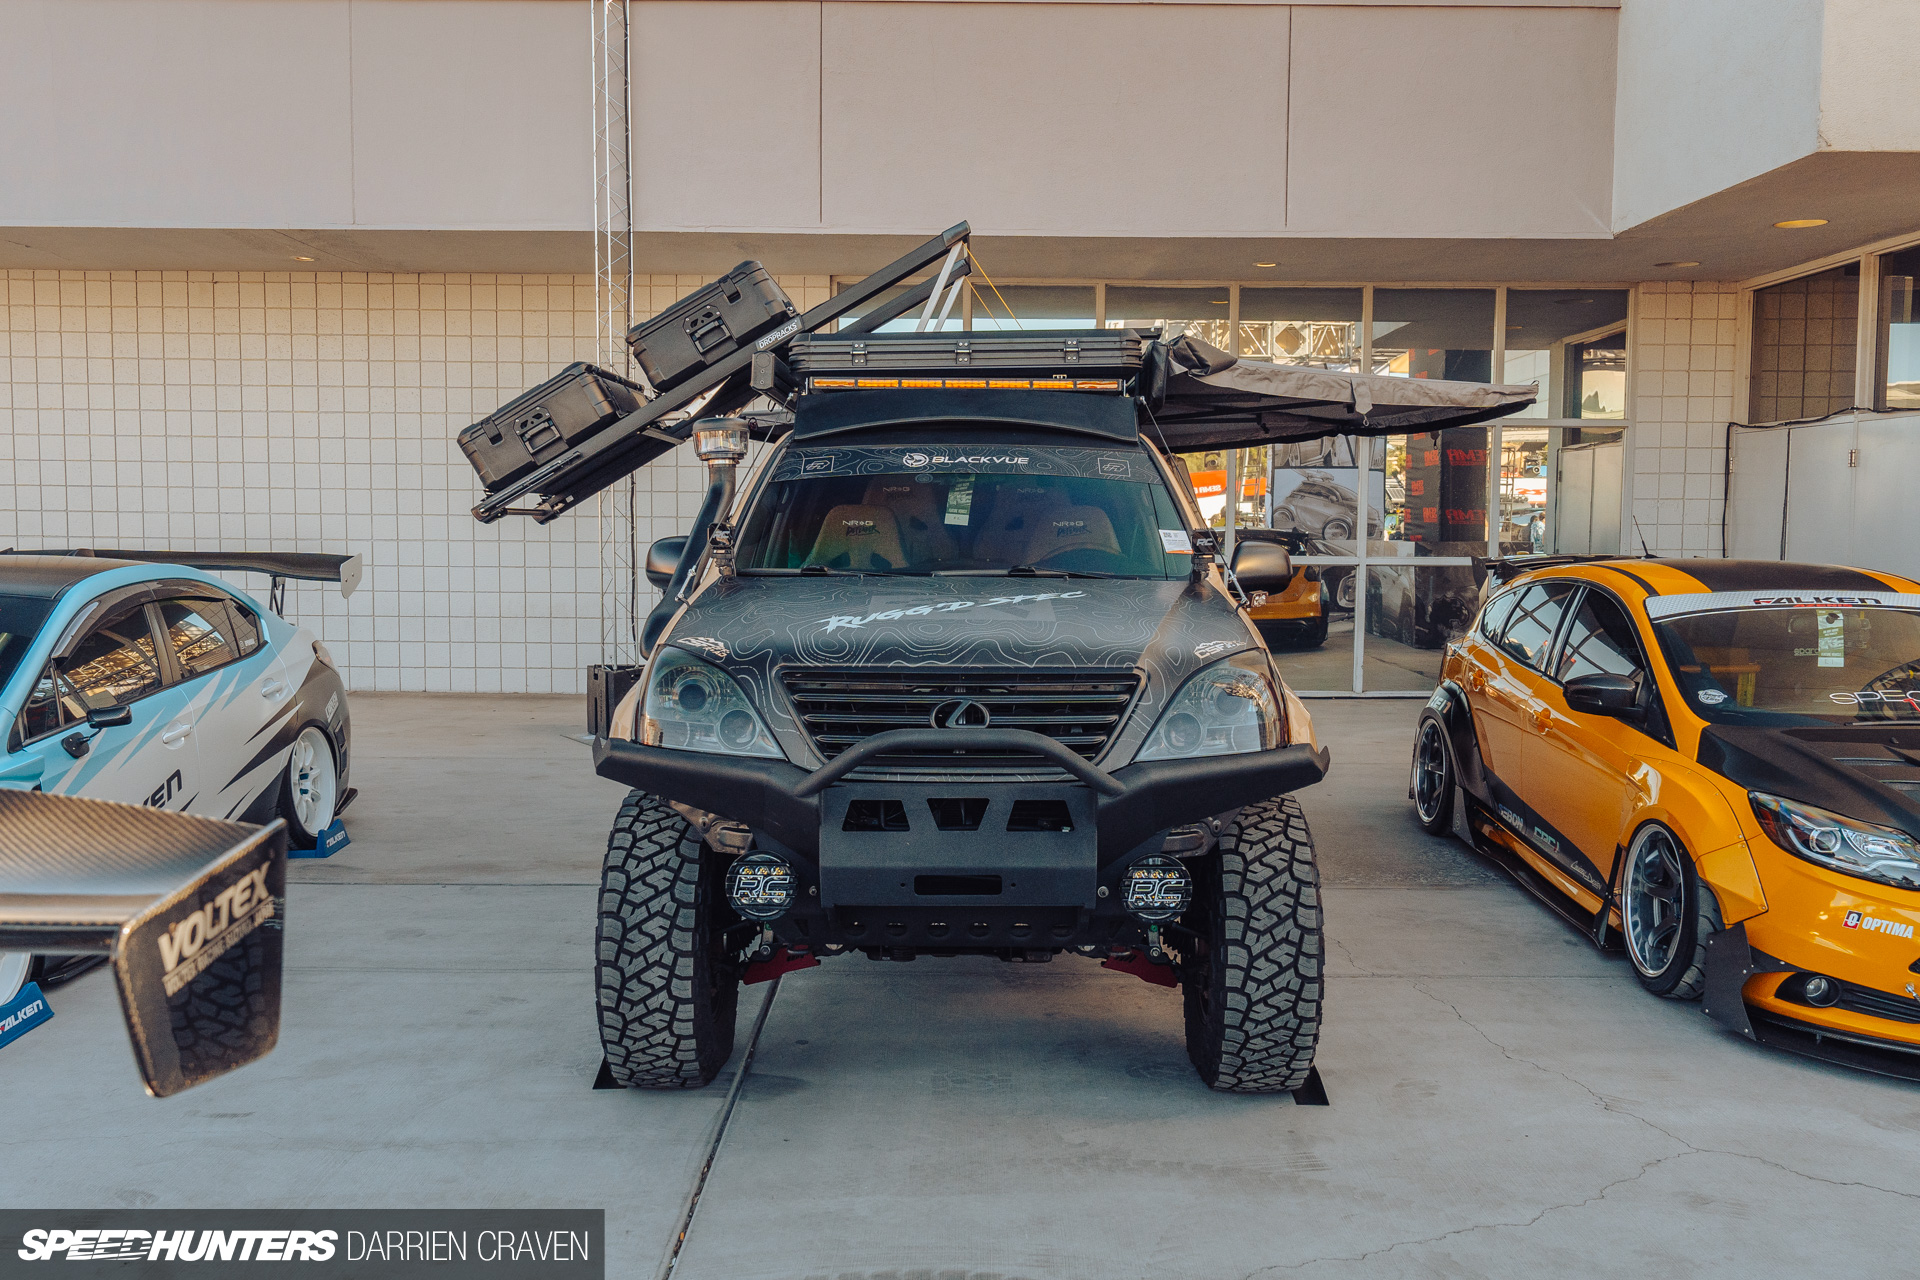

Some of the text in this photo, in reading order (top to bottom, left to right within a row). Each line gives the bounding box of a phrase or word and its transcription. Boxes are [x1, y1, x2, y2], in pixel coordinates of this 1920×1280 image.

[759, 322, 798, 349] DROPRACKS
[931, 456, 1030, 465] BLACKVUE
[1196, 538, 1213, 546] RC
[976, 590, 1087, 607] SPEC
[1753, 596, 1882, 605] FALKEN
[1194, 643, 1224, 658] CSF
[1498, 803, 1524, 831] SEBON
[326, 830, 346, 848] FALKEN
[733, 875, 790, 897] RC
[1128, 879, 1185, 901] RC
[158, 861, 271, 973] VOLTEX
[1861, 916, 1914, 939] OPTIMA
